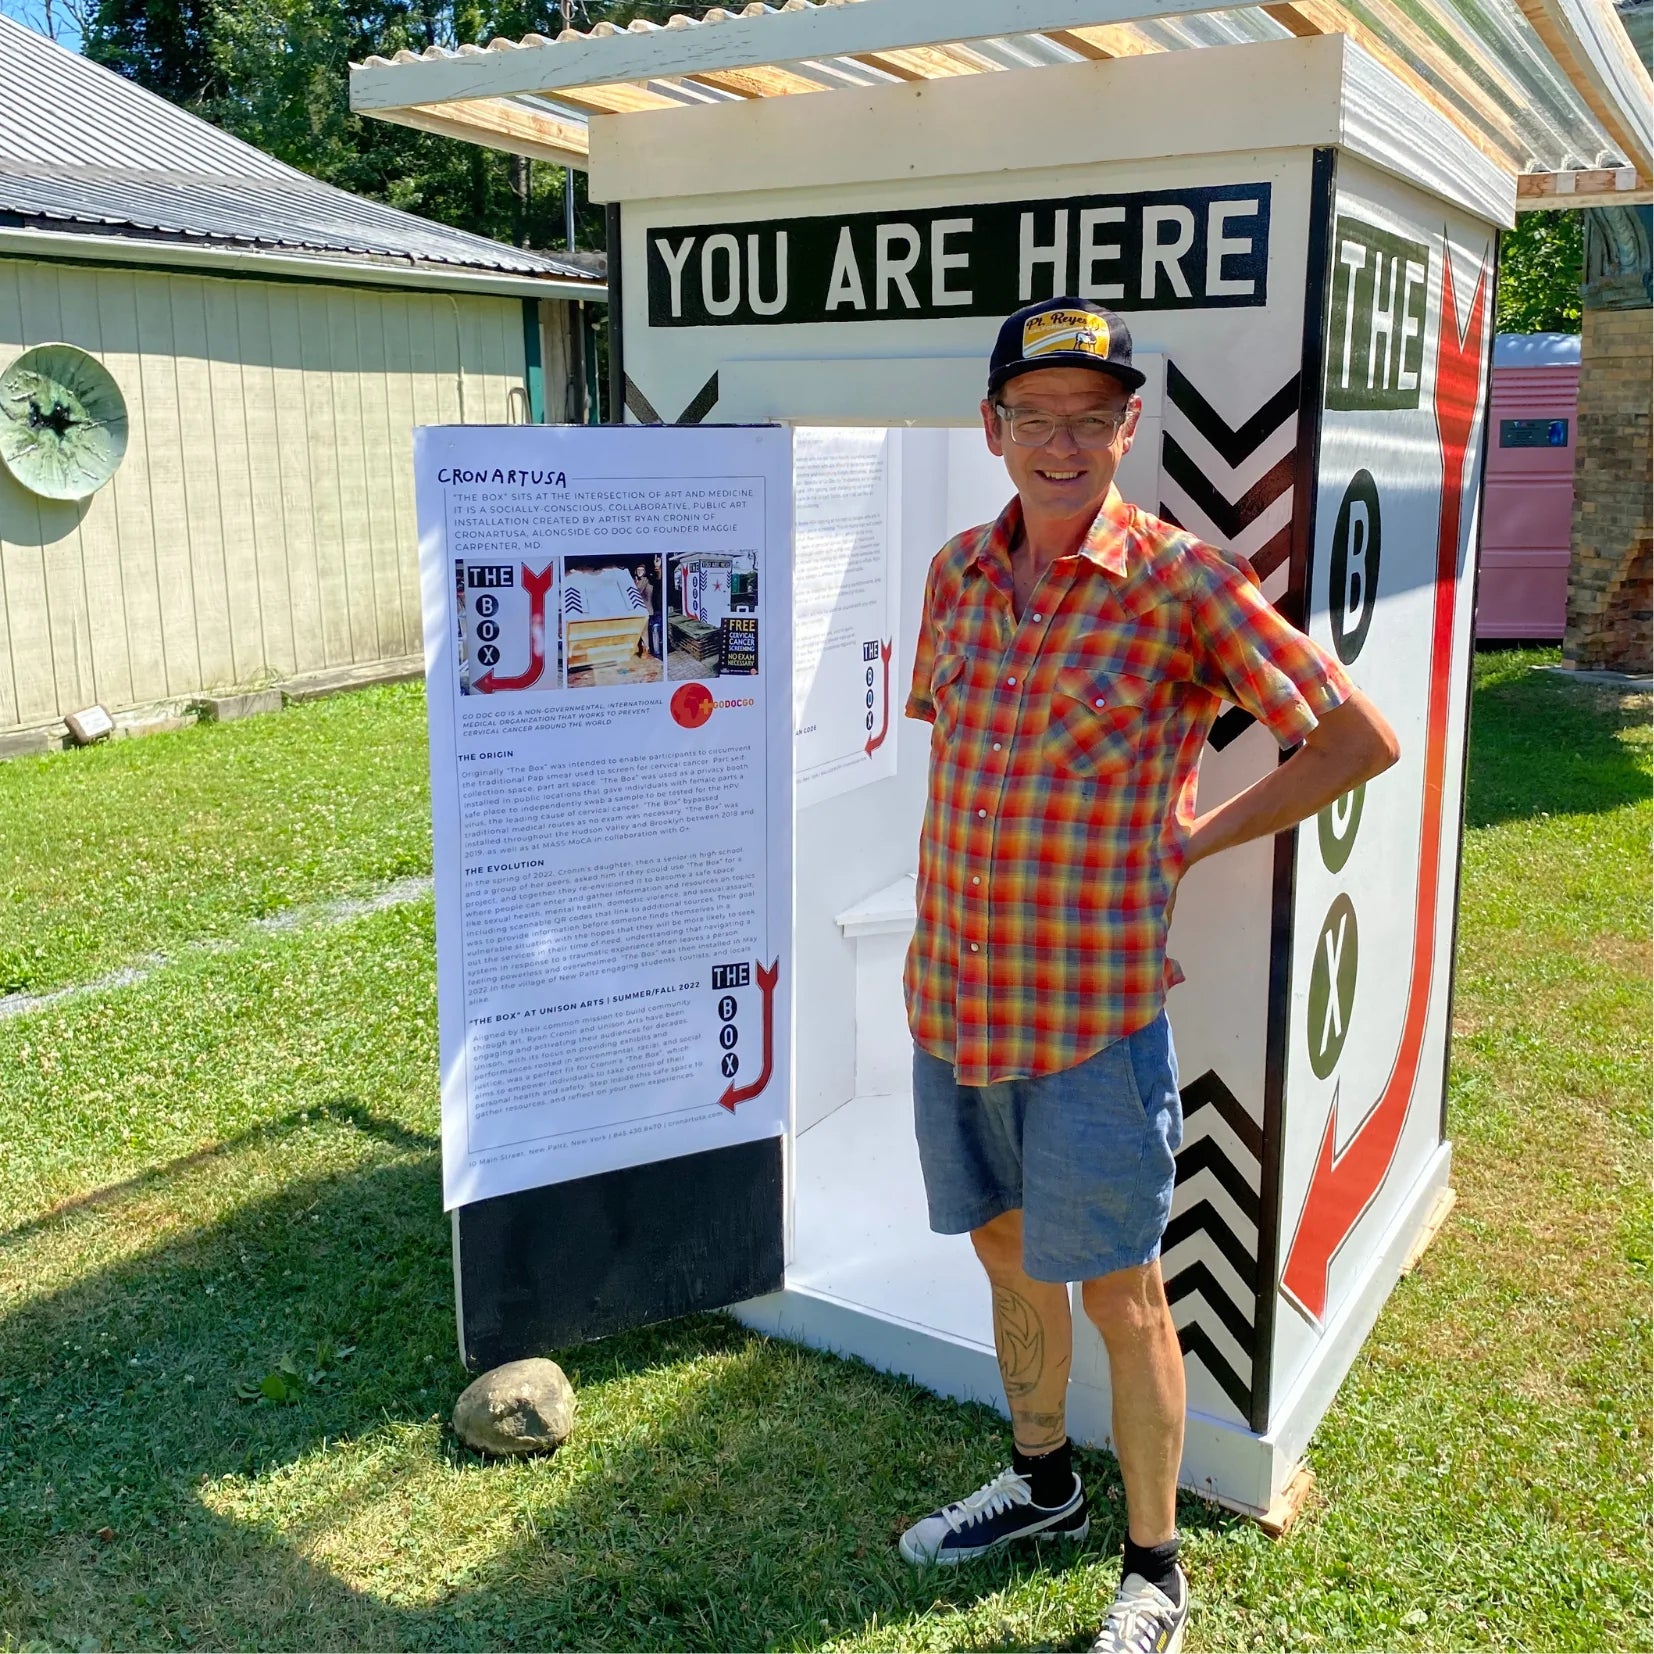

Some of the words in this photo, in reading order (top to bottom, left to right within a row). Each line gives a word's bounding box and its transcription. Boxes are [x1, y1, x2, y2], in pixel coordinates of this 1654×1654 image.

[656, 229, 789, 317] YOU
[826, 217, 974, 312] ARE
[1019, 199, 1260, 302] HERE
[1051, 312, 1087, 325] Reyes
[1340, 240, 1425, 390] THE
[438, 469, 566, 488] CRONARTUSA
[552, 492, 570, 500] THE
[574, 491, 645, 499] INTERSECTION
[664, 490, 682, 498] ART
[693, 501, 726, 509] PUBLIC
[729, 500, 745, 508] ART
[454, 517, 529, 526] INSTALLATION
[532, 516, 579, 524] CREATED
[598, 515, 630, 523] ARTIST
[634, 514, 659, 522] RYAN
[663, 513, 699, 521] CRONIN
[532, 528, 590, 536] ALONGSIDE
[593, 527, 608, 535] GO
[635, 526, 649, 534] GO
[653, 525, 699, 533] FOUNDER
[702, 524, 737, 532] MAGGIE
[469, 567, 512, 586] THE
[729, 619, 755, 632] FREE
[864, 641, 878, 661] THE
[607, 699, 662, 708] INTERNATIONAL
[462, 720, 495, 728] MEDICAL
[499, 716, 555, 724] ORGANIZATION
[462, 728, 498, 736] CERVICAL
[459, 753, 475, 762] THE
[479, 751, 513, 759] ORIGIN
[465, 866, 483, 876] THE
[487, 860, 544, 872] EVOLUTION
[713, 964, 748, 987] THE
[524, 1009, 535, 1017] AT
[539, 1003, 576, 1014] UNISON
[580, 998, 603, 1008] ARTS
[612, 986, 674, 1001] SUMMER/FALL
[678, 981, 699, 990] 2022
